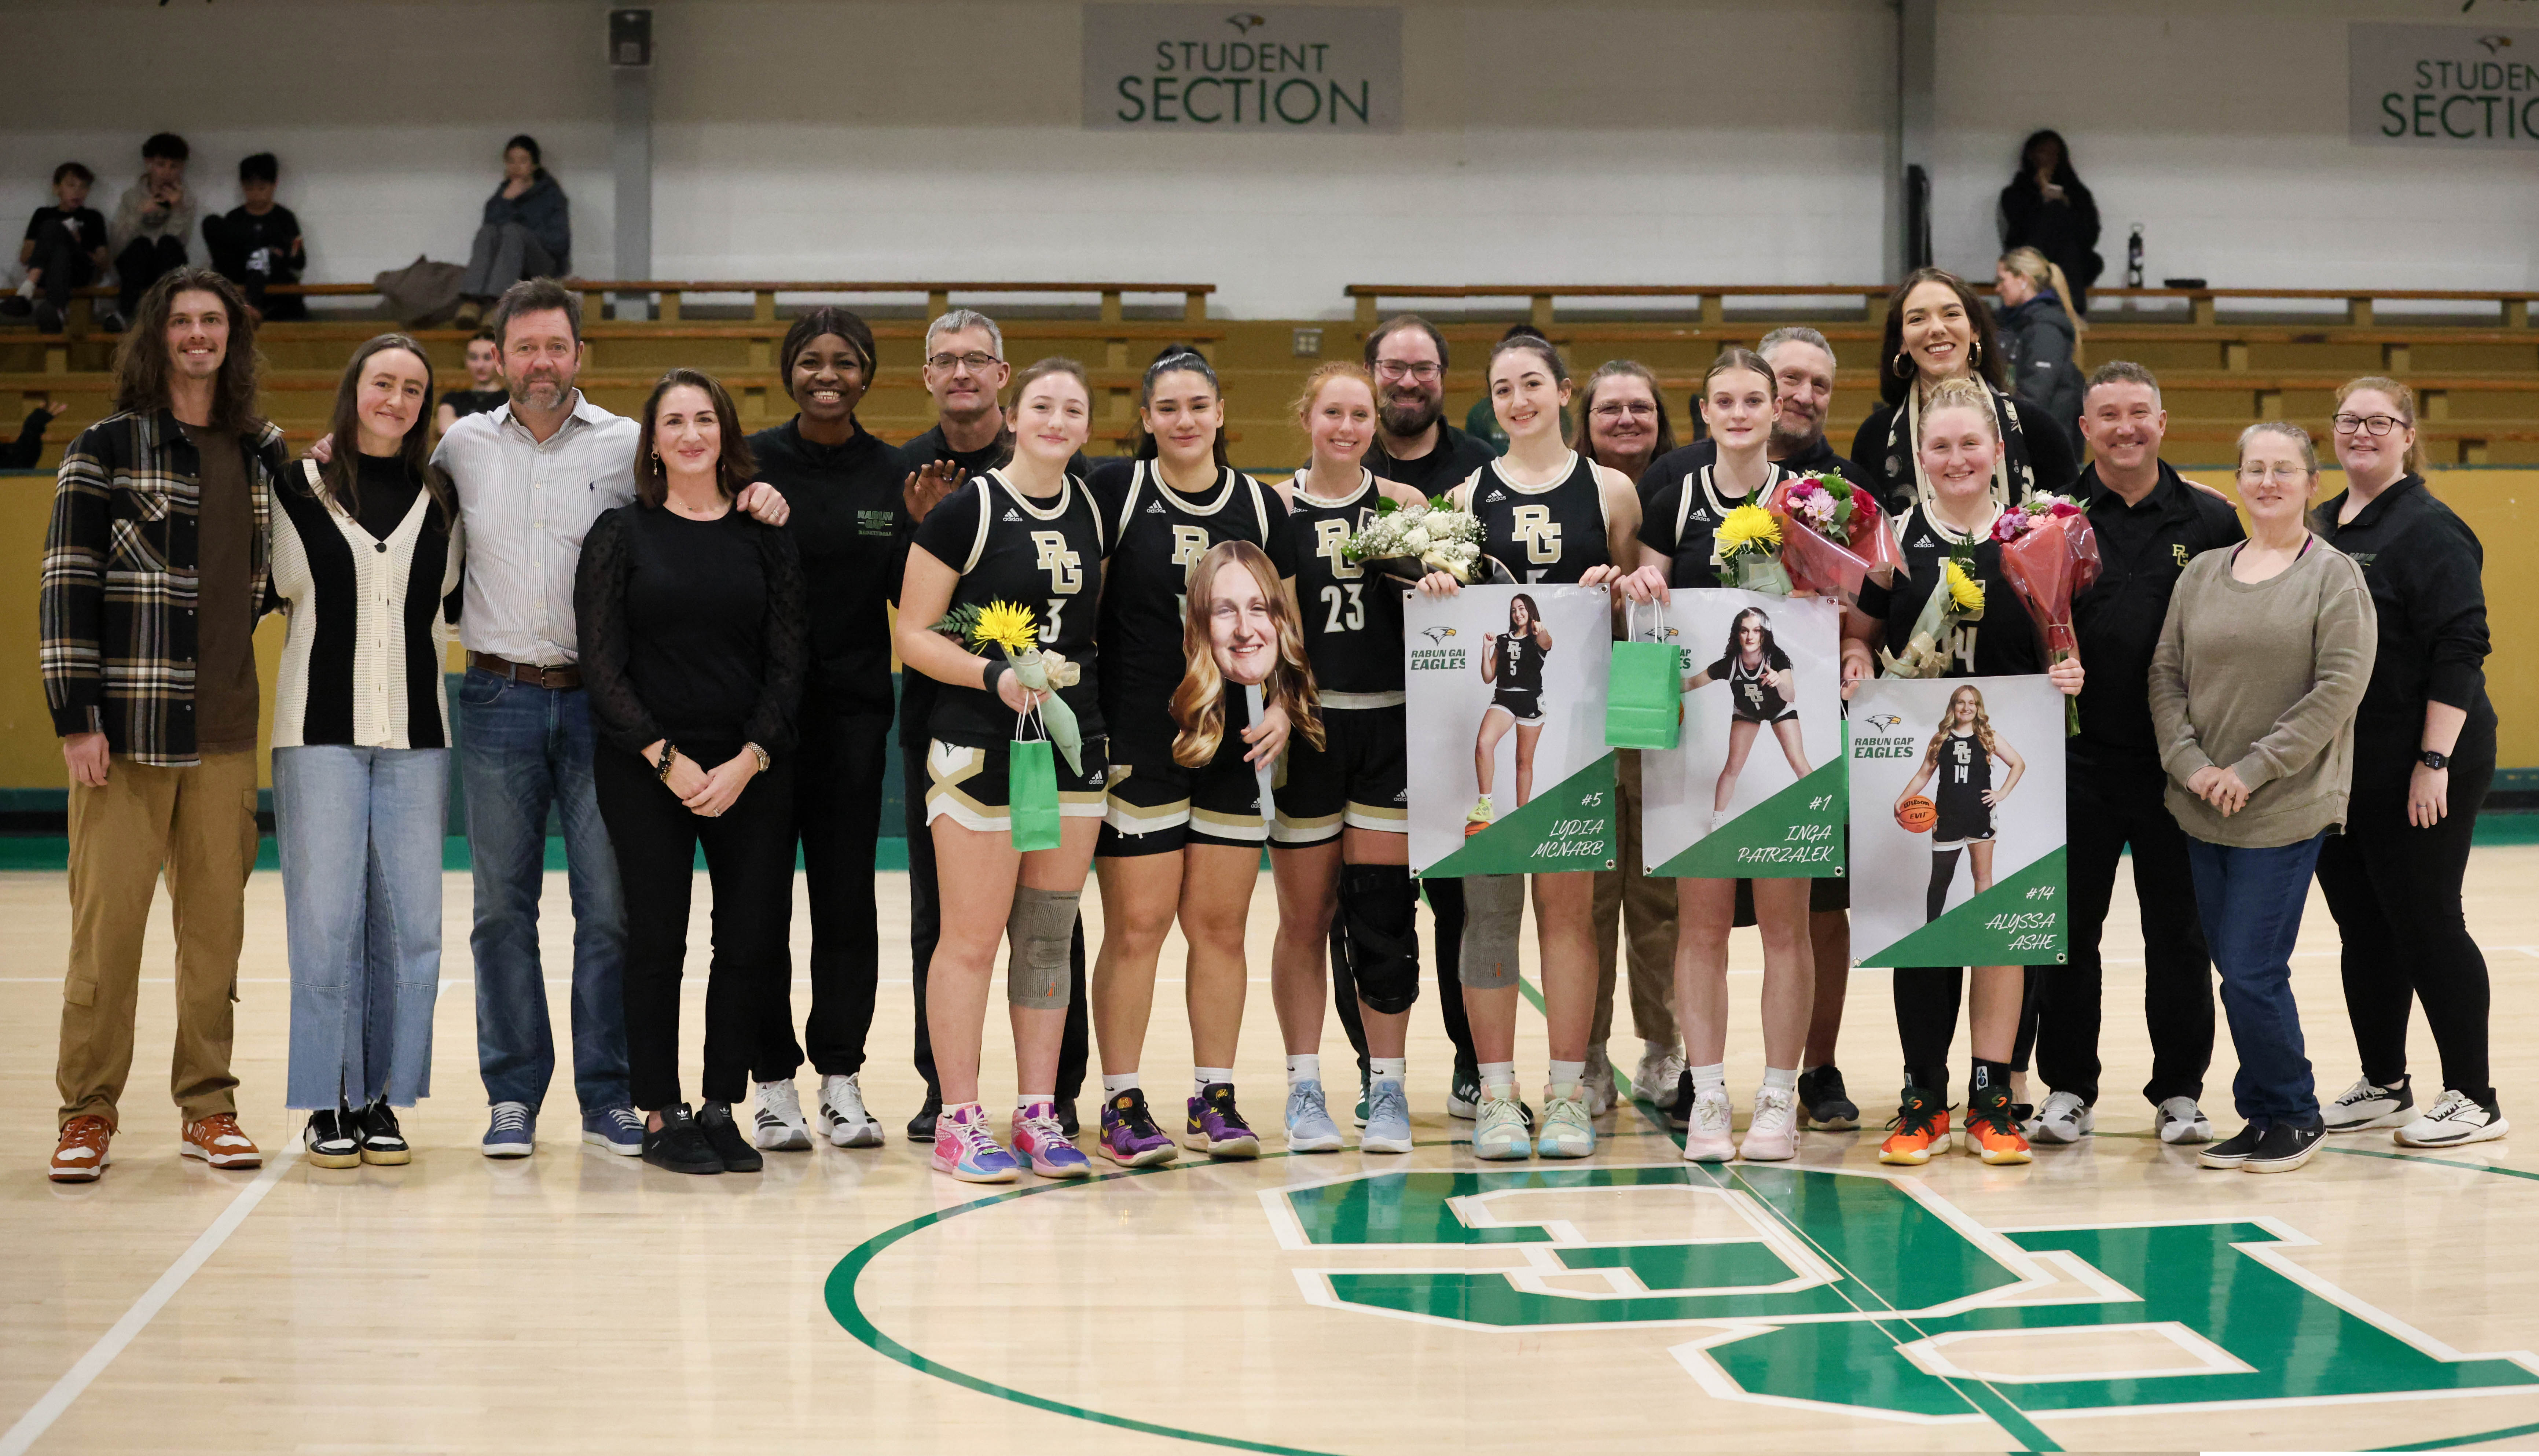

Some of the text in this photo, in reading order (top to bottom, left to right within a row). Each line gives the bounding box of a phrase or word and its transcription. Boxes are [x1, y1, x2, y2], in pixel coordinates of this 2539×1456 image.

[1156, 41, 1329, 73] STUDENT
[2416, 60, 2539, 91] STUDEN
[1117, 76, 1369, 124] SECTION
[2382, 93, 2539, 139] SECTI
[1486, 494, 1507, 503] adidas
[858, 510, 894, 521] RABUN
[1689, 514, 1710, 522] adidas
[1320, 584, 1365, 633] 23
[1038, 599, 1068, 643] 3
[1411, 649, 1446, 658] RABUN
[1411, 658, 1465, 670] EAGLES
[1509, 661, 1517, 676] 5
[1854, 738, 1914, 746] RABUN GAP
[1854, 746, 1914, 758] EAGLES
[1954, 765, 1969, 783] 14
[1581, 792, 1603, 808] #5
[1809, 794, 1832, 812] #1
[1904, 799, 1929, 808] Wilson
[1549, 819, 1604, 841] LYDIA
[1784, 824, 1832, 842] INGA
[1530, 840, 1604, 858] MCNABB
[1738, 846, 1834, 863] PATRZALEK
[2026, 886, 2055, 901] #14
[1985, 912, 2056, 934] ALYSSA
[2008, 934, 2056, 951] ASHE
